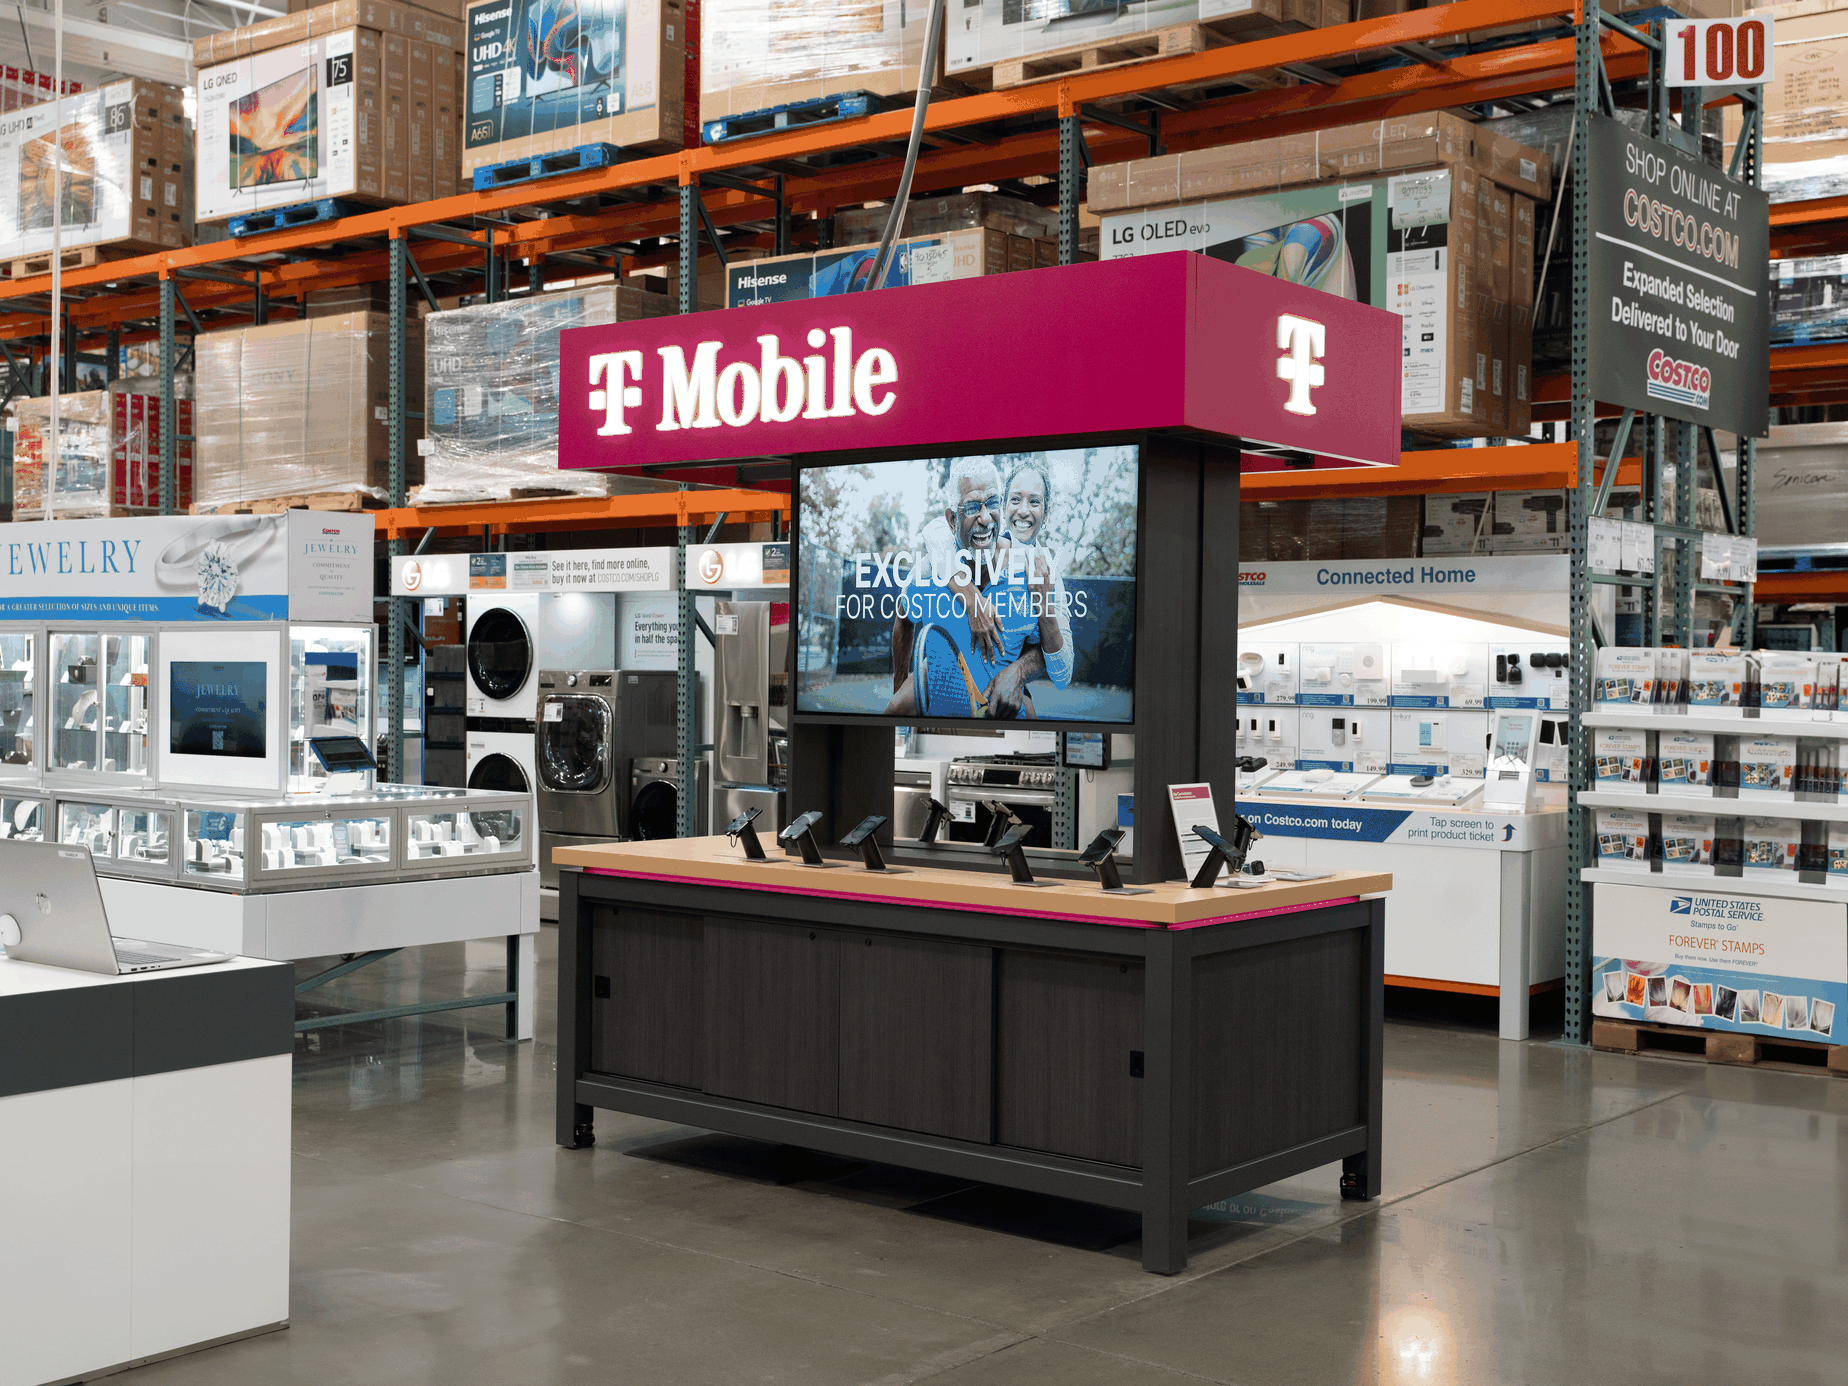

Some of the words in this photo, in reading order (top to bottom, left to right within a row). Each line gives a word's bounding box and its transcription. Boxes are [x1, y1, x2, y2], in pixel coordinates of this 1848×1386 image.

[475, 7, 512, 26] Hisense
[473, 42, 502, 63] UHD
[1678, 20, 1765, 81] 100
[204, 78, 213, 90] LG
[216, 72, 238, 87] QNED
[8, 119, 25, 134] UHD
[1626, 143, 1666, 185] SHOP
[1671, 165, 1721, 213] ONLINE
[1723, 191, 1741, 220] AT
[1350, 188, 1371, 197] matter
[1113, 227, 1134, 245] LG
[1141, 220, 1188, 241] OLED
[1189, 223, 1211, 235] evo
[1623, 188, 1739, 269] COSTCO.COM
[738, 274, 787, 289] Hisense
[1623, 261, 1684, 305] Expanded
[1686, 284, 1735, 323] Selection
[746, 298, 764, 306] Google
[1612, 296, 1672, 338] Delivered
[1675, 317, 1687, 341] to
[1690, 320, 1714, 350] Your
[1716, 330, 1739, 359] Door
[656, 326, 899, 431] Mobile
[0, 539, 142, 575] EWELRY
[303, 543, 358, 556] JEWELRY
[552, 560, 565, 572] See
[566, 560, 571, 571] it
[573, 559, 590, 572] here,
[592, 559, 605, 570] find
[607, 561, 624, 570] more
[626, 558, 650, 570] online,
[855, 548, 1066, 589] EXCLUSIVELY
[552, 573, 565, 586] buy
[566, 573, 571, 584] it
[573, 574, 587, 583] now
[589, 573, 596, 583] at
[597, 571, 660, 583] COSTCO.COM/SHOPLG
[1317, 567, 1415, 585] Connected
[1421, 566, 1476, 583] Home
[11, 602, 38, 612] GREATER
[38, 602, 71, 612] SELECTION
[71, 603, 80, 612] OF
[80, 603, 98, 612] SIZES
[98, 603, 112, 612] AND
[112, 603, 138, 614] UNIQUE
[835, 594, 874, 619] FOR
[880, 592, 967, 619] COSTCO
[974, 590, 1088, 618] MEMBERS
[634, 621, 668, 633] Everything
[634, 634, 640, 644] in
[641, 634, 653, 644] half
[655, 634, 665, 644] the
[666, 636, 678, 646] spa
[195, 684, 239, 699] JEWELRY
[1302, 711, 1314, 720] ring
[1461, 768, 1483, 776] 329.99
[1247, 814, 1261, 824] on
[1264, 812, 1329, 829] Costco.com
[1331, 817, 1363, 833] today
[1429, 816, 1447, 829] Tap
[1450, 819, 1482, 830] screen
[1485, 819, 1494, 830] to
[1408, 827, 1428, 839] print
[1431, 828, 1467, 841] product
[1469, 831, 1495, 842] ticket
[1695, 897, 1728, 909] UNITED
[1729, 900, 1761, 912] STATES
[1693, 907, 1726, 919] POSTAL
[1727, 910, 1764, 922] SERVICE
[1690, 920, 1716, 930] Stamps
[1717, 923, 1725, 931] to
[1721, 939, 1765, 955] STAMPS
